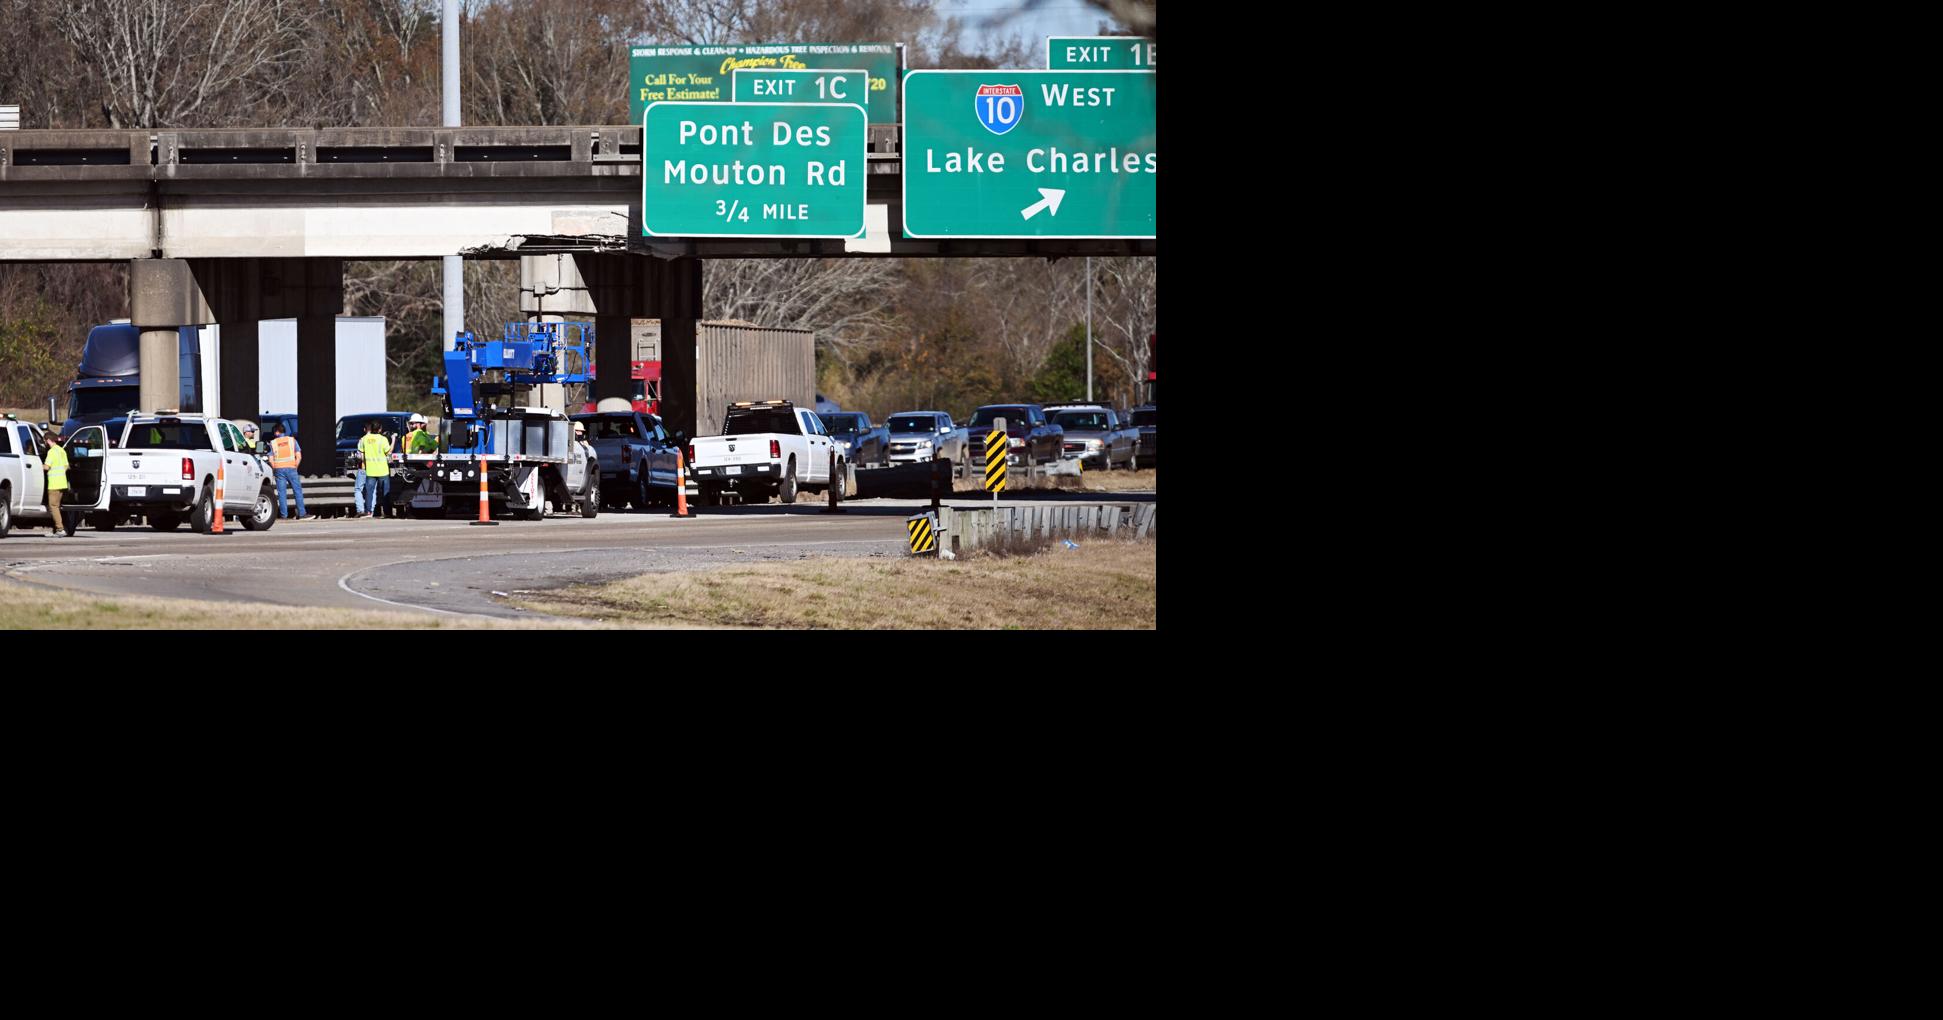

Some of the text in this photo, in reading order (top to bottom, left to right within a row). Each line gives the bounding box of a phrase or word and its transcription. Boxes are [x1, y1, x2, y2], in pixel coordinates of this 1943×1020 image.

[658, 48, 692, 56] RESPONSE
[694, 47, 700, 55] &
[746, 46, 789, 54] HAZARDOUS
[791, 46, 807, 54] TREE
[809, 46, 849, 54] INSPECTION
[851, 46, 857, 54] &
[1066, 47, 1110, 62] EXIT
[645, 73, 713, 85] Call For Your
[753, 76, 847, 99] EXIT 1C
[640, 87, 720, 101] Free Estimate!
[983, 87, 1016, 95] INTERSTATE
[1041, 84, 1115, 107] WEST
[986, 97, 1015, 124] 10
[679, 120, 831, 147] Pont Des
[927, 147, 1156, 173] Lake Charles
[664, 160, 846, 186] Mouton Rd
[716, 200, 809, 223] 3/4 MILE
